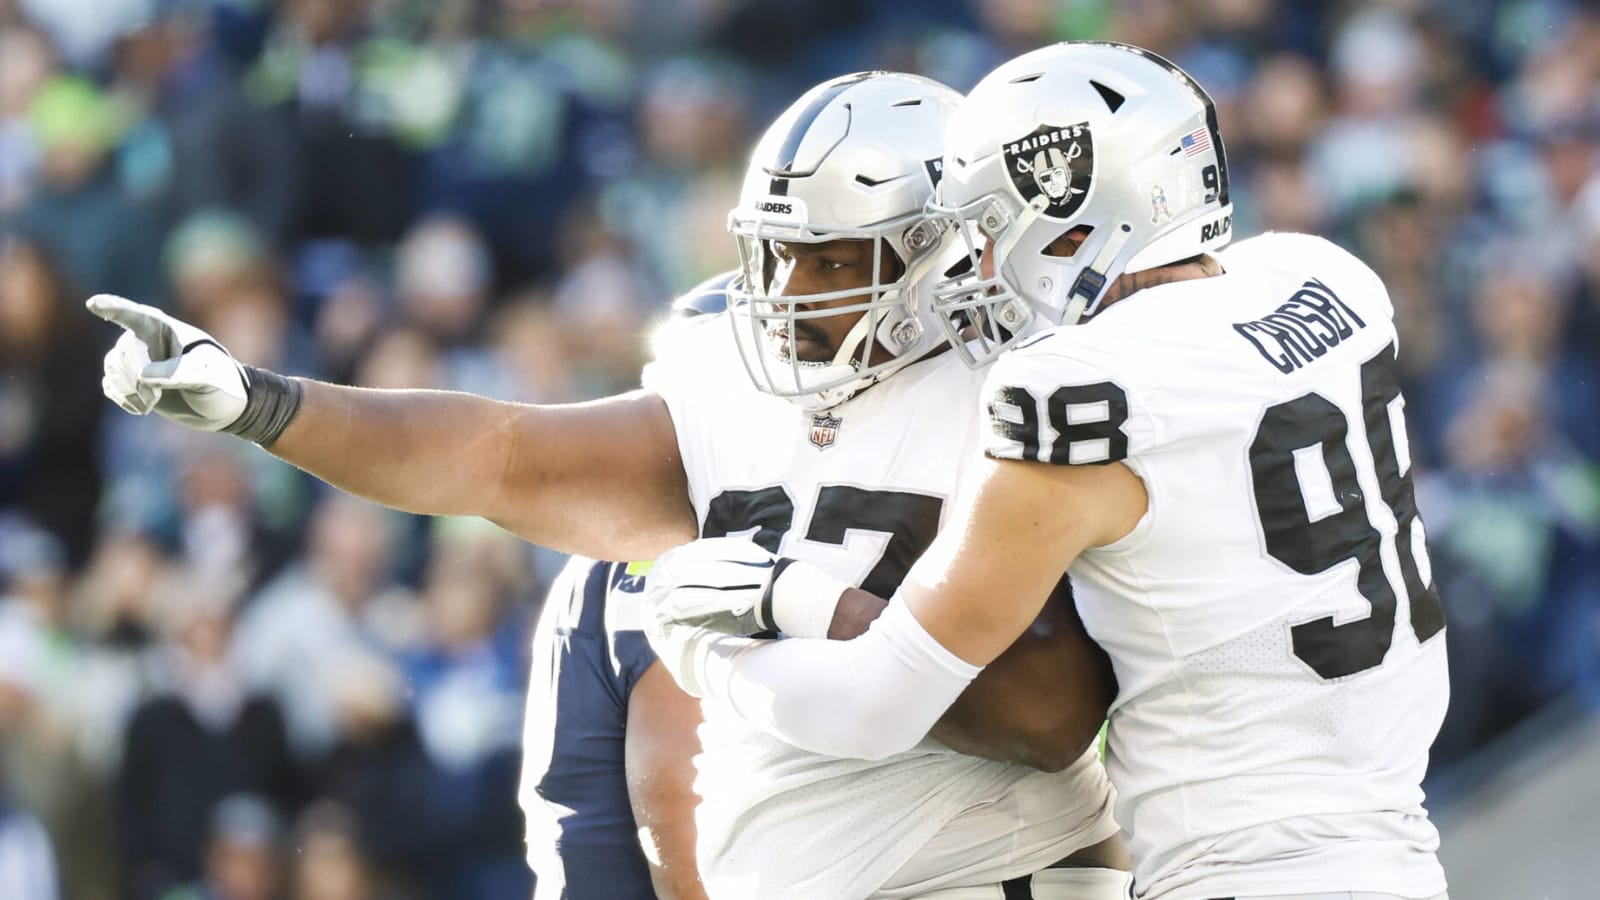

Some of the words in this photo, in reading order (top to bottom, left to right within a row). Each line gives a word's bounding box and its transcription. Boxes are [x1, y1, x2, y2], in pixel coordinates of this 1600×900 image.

[1009, 126, 1082, 155] RAIDERS
[1232, 277, 1366, 374] CROSBY
[813, 428, 834, 443] NFL
[985, 381, 1128, 465] 98
